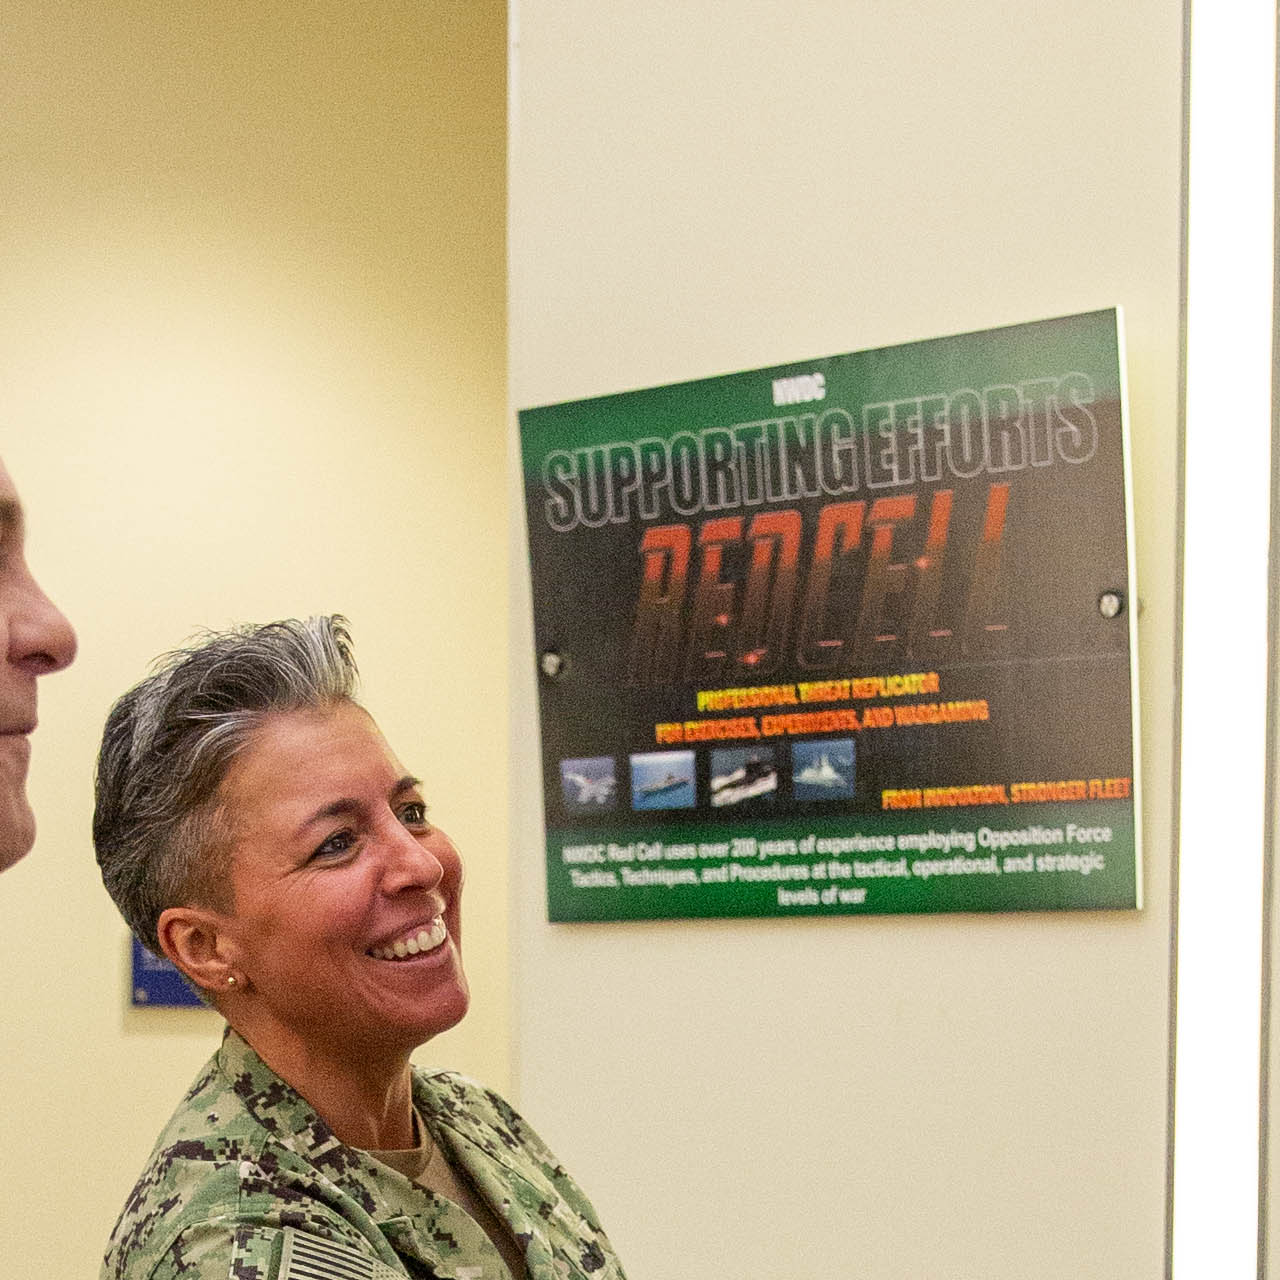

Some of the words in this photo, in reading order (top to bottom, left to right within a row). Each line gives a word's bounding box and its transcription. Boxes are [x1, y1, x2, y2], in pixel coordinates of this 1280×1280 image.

[542, 407, 856, 532] SUPPORTING
[863, 372, 1097, 490] EFFORTS
[1088, 777, 1131, 800] FLEET
[698, 842, 729, 859] over
[758, 839, 797, 860] years
[799, 834, 816, 855] of
[816, 834, 896, 857] experience
[896, 829, 976, 853] employing
[977, 826, 1065, 851] Opposition
[1066, 823, 1112, 845] Force
[701, 863, 729, 884] and
[729, 862, 810, 883] Procedures
[811, 862, 827, 880] at
[828, 861, 851, 880] the
[912, 854, 1001, 880] operational,
[1002, 853, 1034, 873] and
[1035, 850, 1105, 875] strategic
[777, 886, 819, 906] levels
[820, 884, 838, 904] of
[838, 886, 867, 905] war
